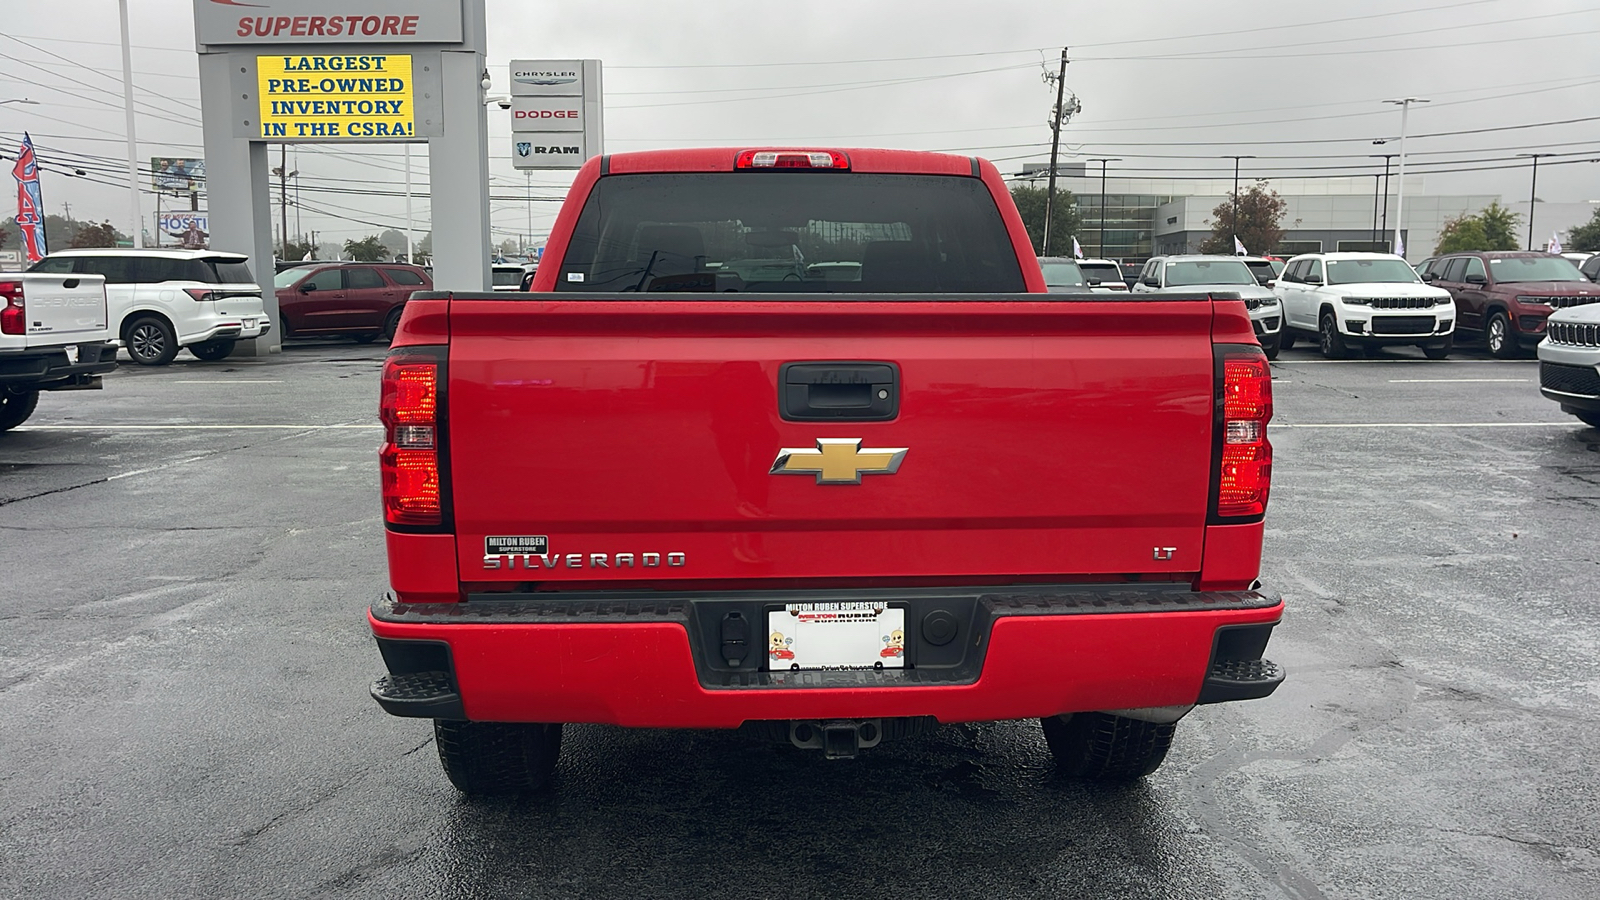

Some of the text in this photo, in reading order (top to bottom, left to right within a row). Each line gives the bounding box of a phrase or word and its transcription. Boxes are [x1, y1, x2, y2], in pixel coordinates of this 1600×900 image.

[237, 16, 419, 37] SUPERSTORE
[284, 56, 387, 71] LARGEST
[268, 78, 405, 93] PRE-OWNED
[271, 100, 404, 115] INVENTORY
[514, 110, 579, 119] DODGE
[263, 121, 413, 137] IN THE CSRA!
[534, 146, 580, 154] RAM
[488, 537, 545, 546] MILTON RUBEN
[483, 552, 686, 569] SILVERADO
[1153, 546, 1177, 560] LT
[785, 601, 889, 612] MILTON RUBEN SUPERSTORE
